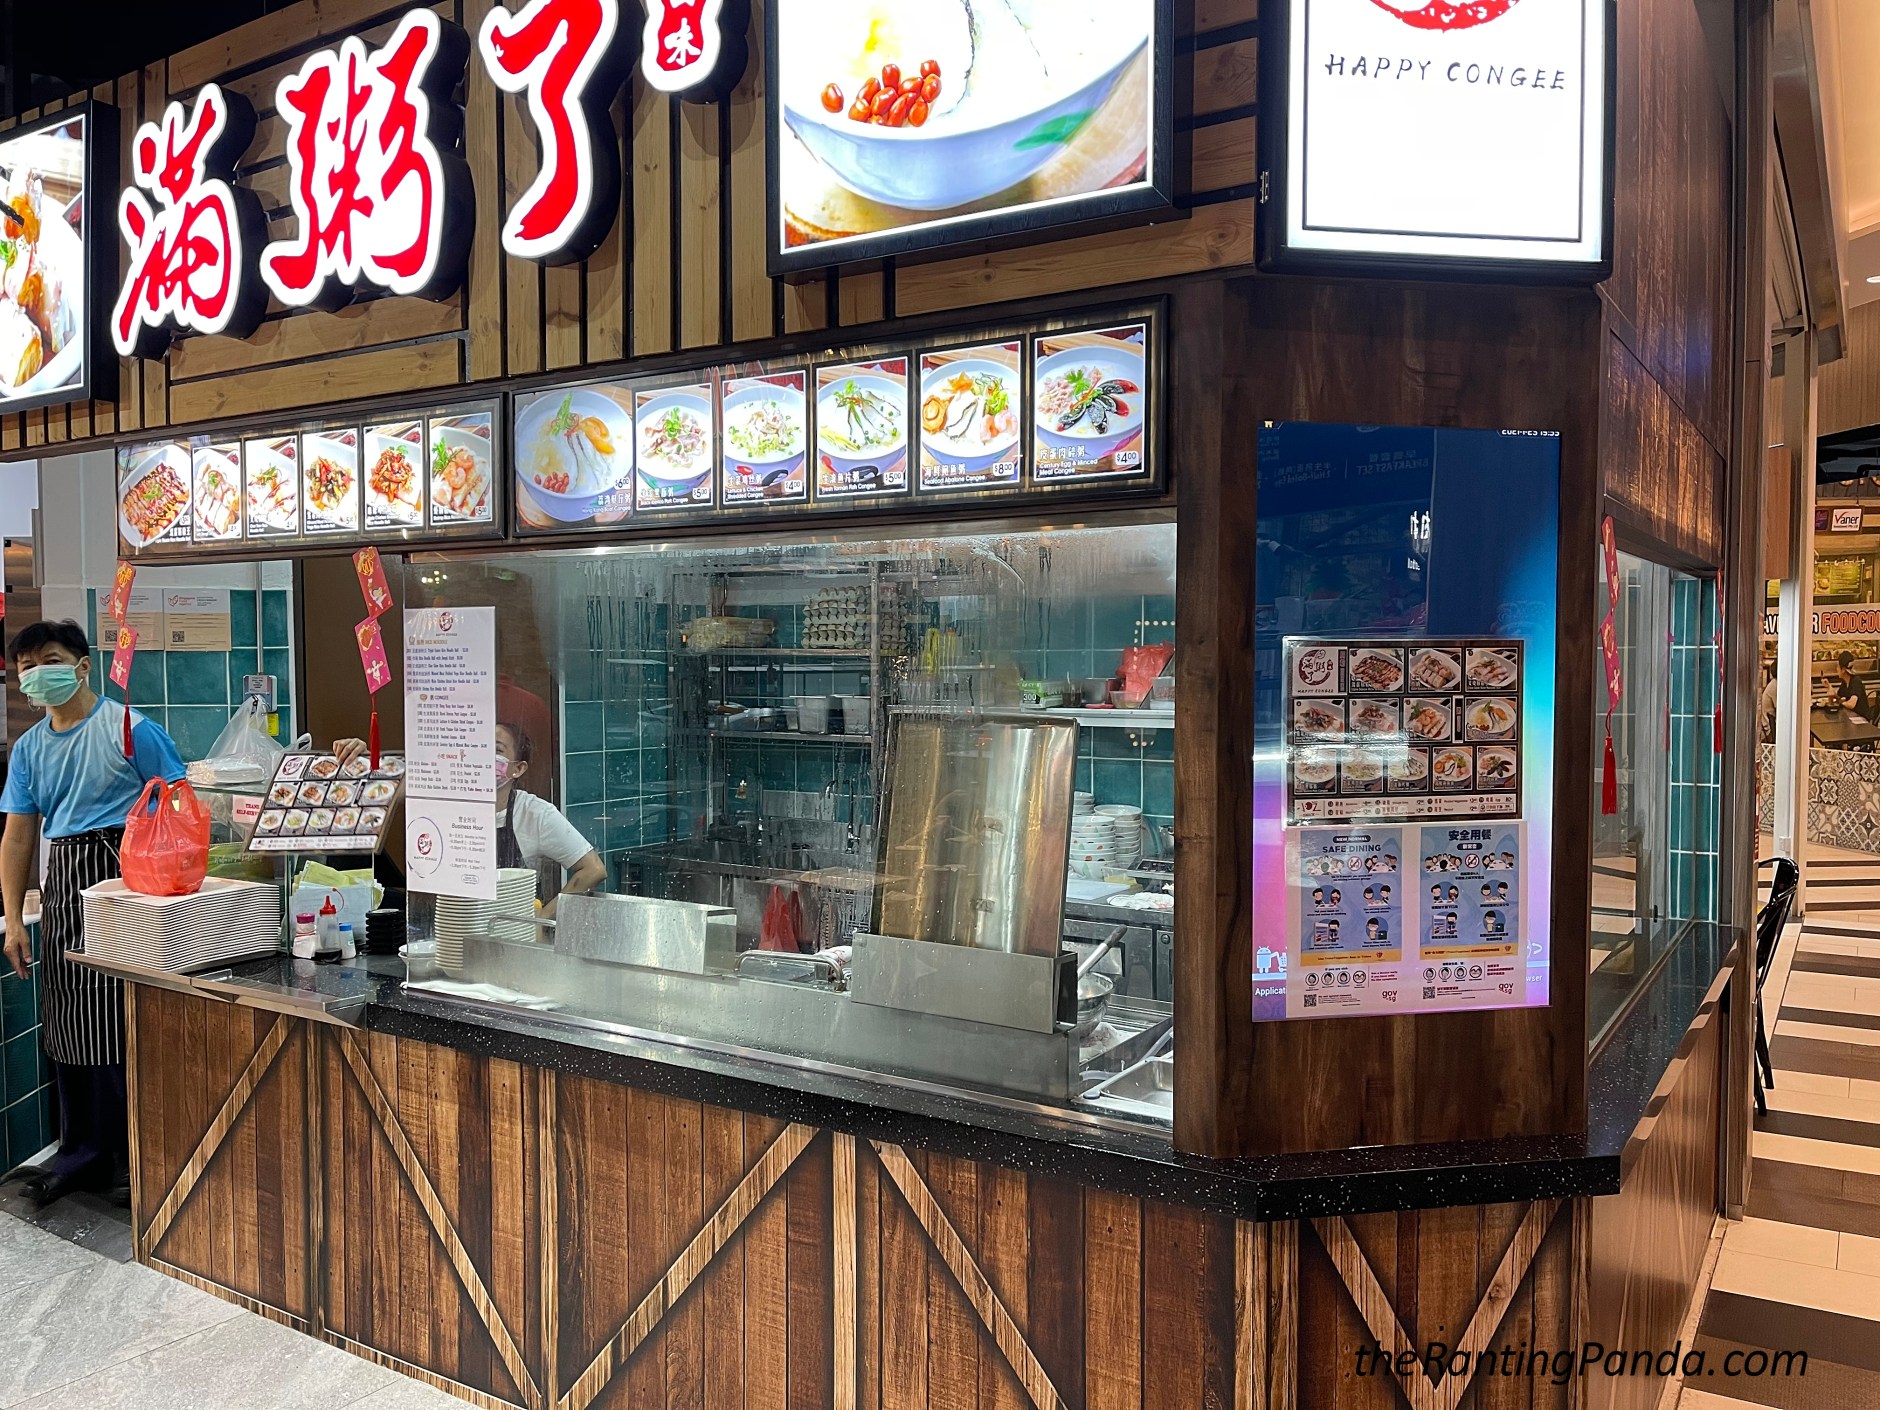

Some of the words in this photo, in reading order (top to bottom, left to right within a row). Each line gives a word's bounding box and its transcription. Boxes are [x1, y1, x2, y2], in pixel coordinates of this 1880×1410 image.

[1325, 53, 1431, 80] HAPPY
[1446, 62, 1566, 90] CONGEE
[1835, 512, 1859, 524] Vaner
[1448, 829, 1492, 841] 安全用餐
[1255, 986, 1286, 997] Applicat
[1499, 983, 1514, 991] gov
[1382, 990, 1397, 998] gov
